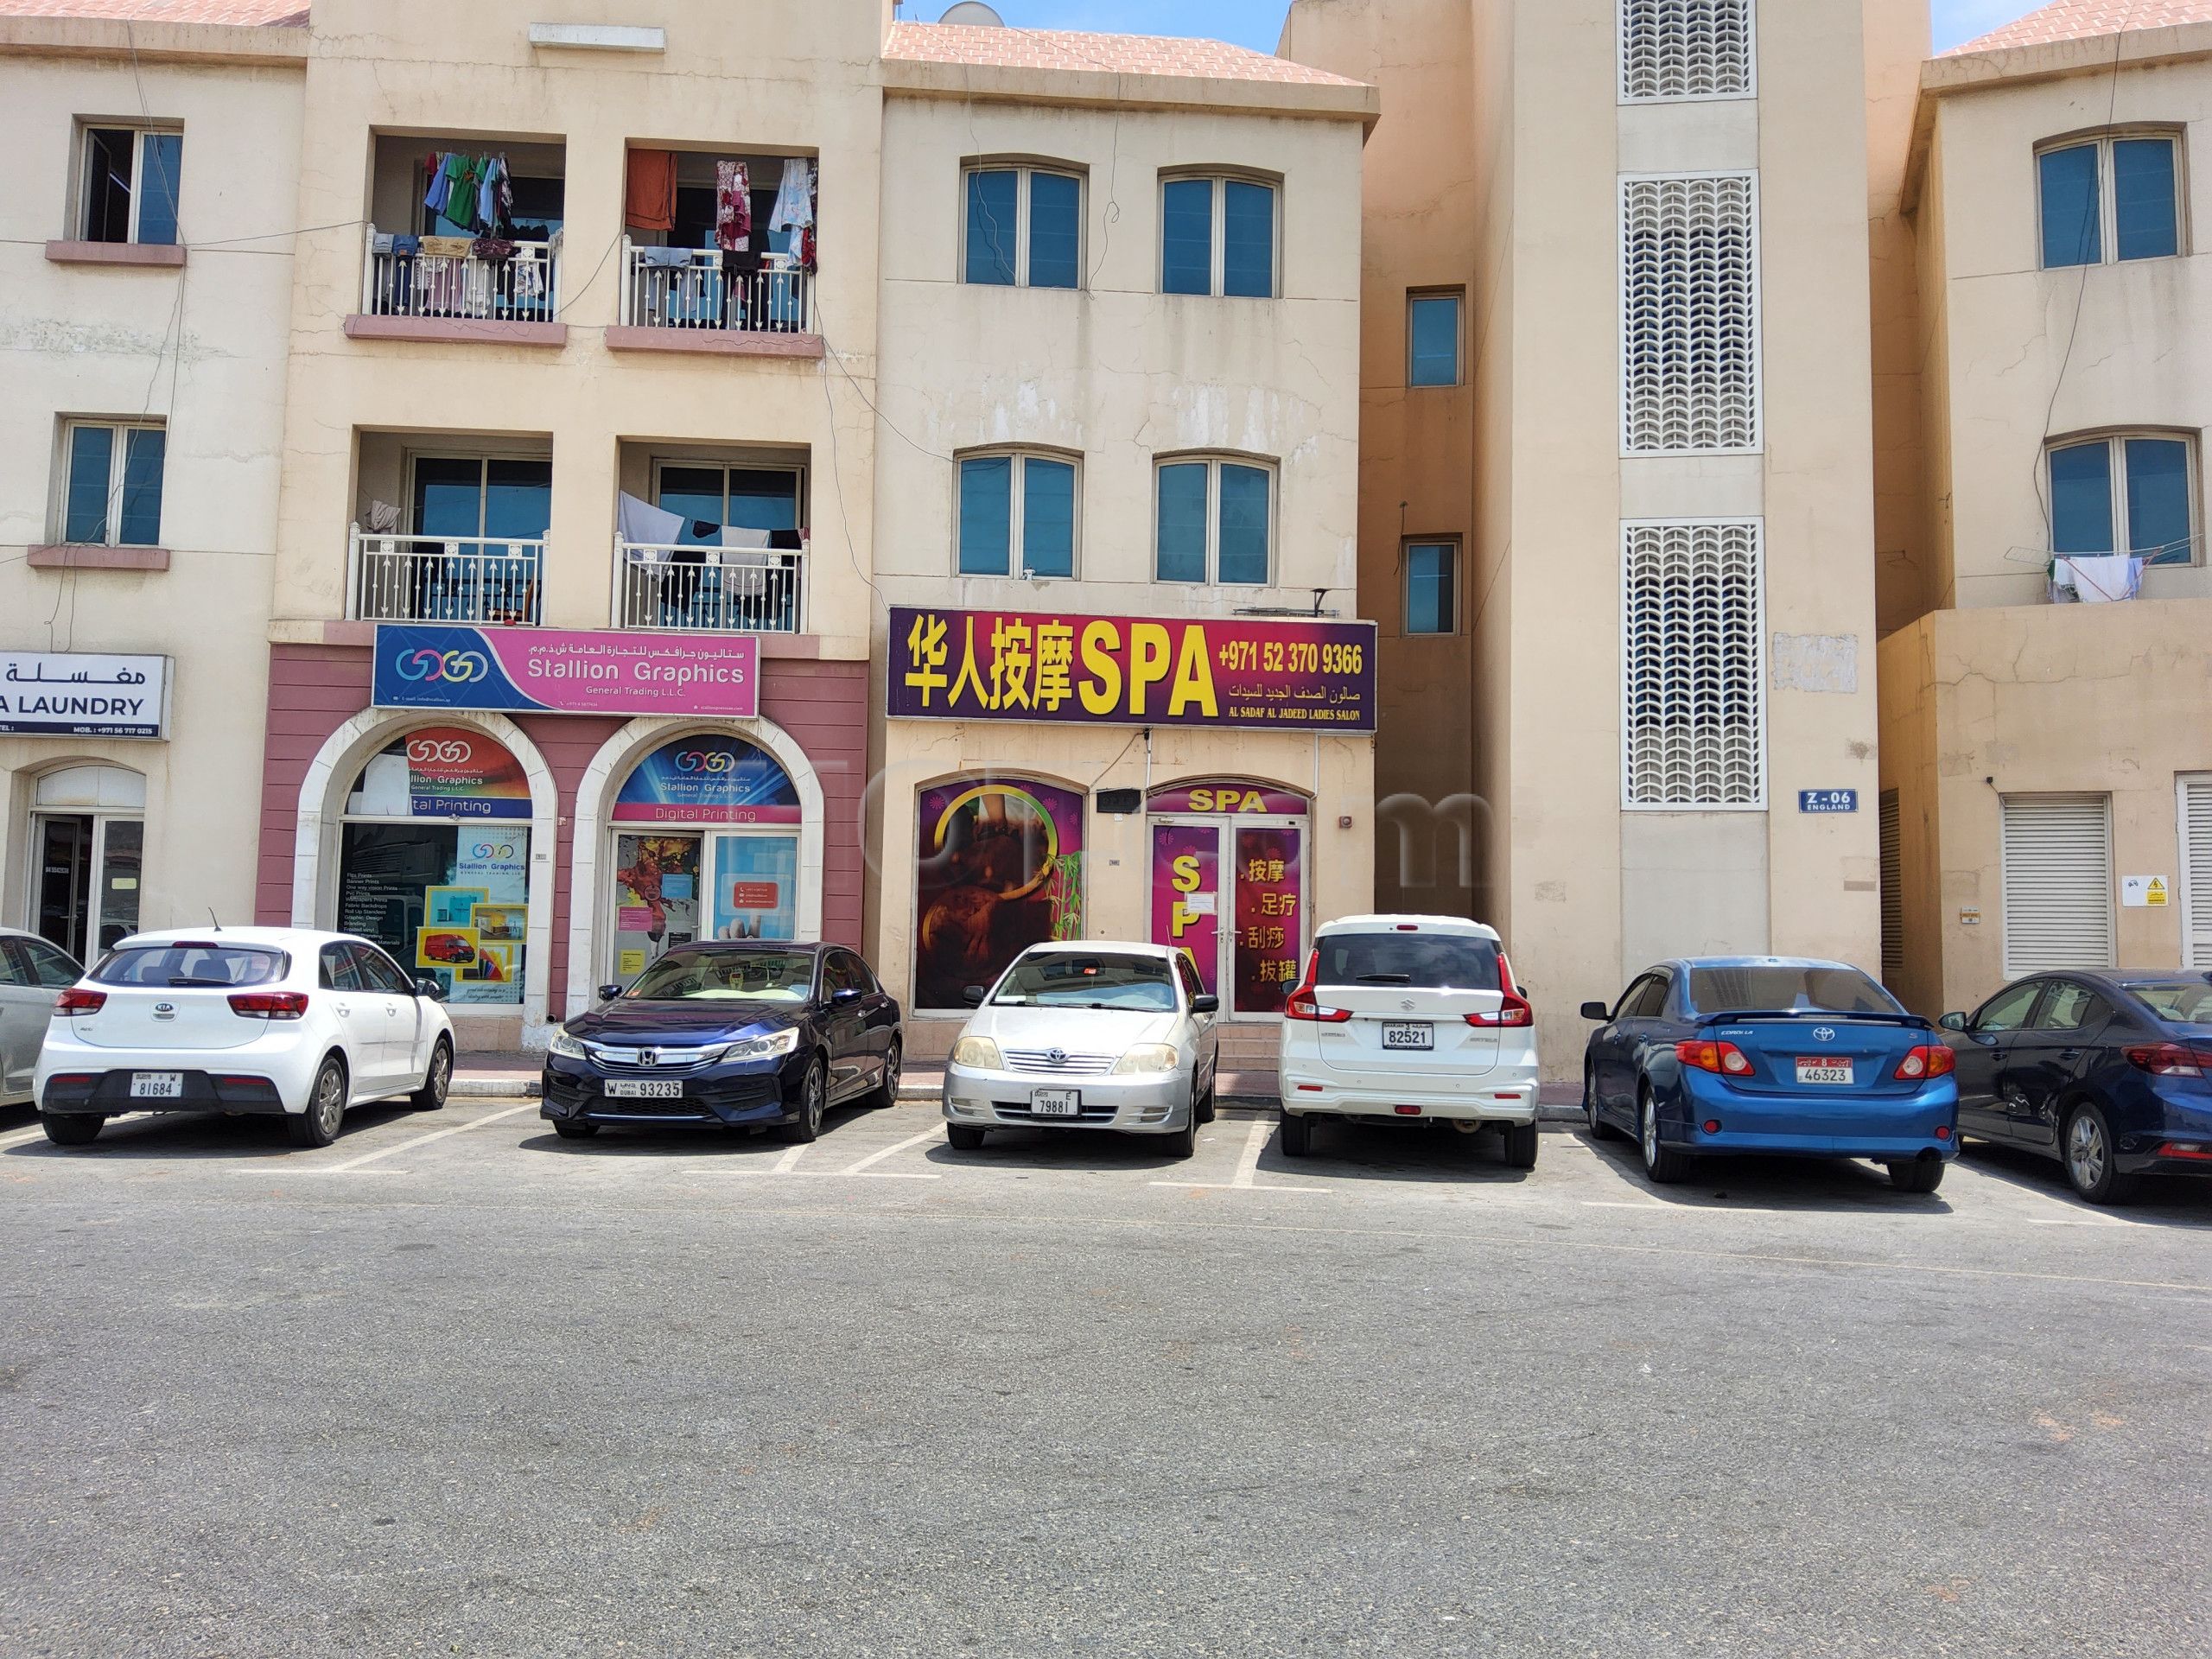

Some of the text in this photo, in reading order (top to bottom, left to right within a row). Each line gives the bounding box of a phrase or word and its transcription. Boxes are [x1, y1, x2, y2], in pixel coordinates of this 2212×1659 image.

[905, 613, 1073, 711] 华人按摩
[1219, 640, 1363, 674] +971 52 370 9366
[6, 662, 146, 685] مغسلة
[527, 658, 745, 686] Stallion Graphics
[1079, 620, 1219, 717] SPA
[586, 686, 622, 695] General
[624, 687, 659, 697] Trading
[1229, 683, 1361, 704] صالون الصدف الجديد للسيدات
[18, 696, 144, 716] LAUNDRY
[1229, 707, 1360, 721] AL SADAF AL JADEED LADIES SALON
[437, 775, 483, 785] Graphics
[660, 782, 751, 793] Stallion Graphics
[1188, 789, 1268, 813] SPA
[1807, 792, 1818, 804] Z
[1830, 791, 1851, 804] 06
[435, 799, 491, 814] Printing
[656, 808, 756, 823] Digital Printing
[1249, 858, 1285, 883] 按摩
[1261, 893, 1297, 916] 足疗
[1248, 925, 1285, 950] 刮痧
[1260, 959, 1297, 982] 拔罐
[1389, 1030, 1426, 1044] 82521
[1805, 1069, 1846, 1082] 46323
[139, 1083, 172, 1095] 81684
[607, 1083, 680, 1096] W 93235
[1065, 1092, 1071, 1101] E
[1039, 1100, 1068, 1114] 79881
